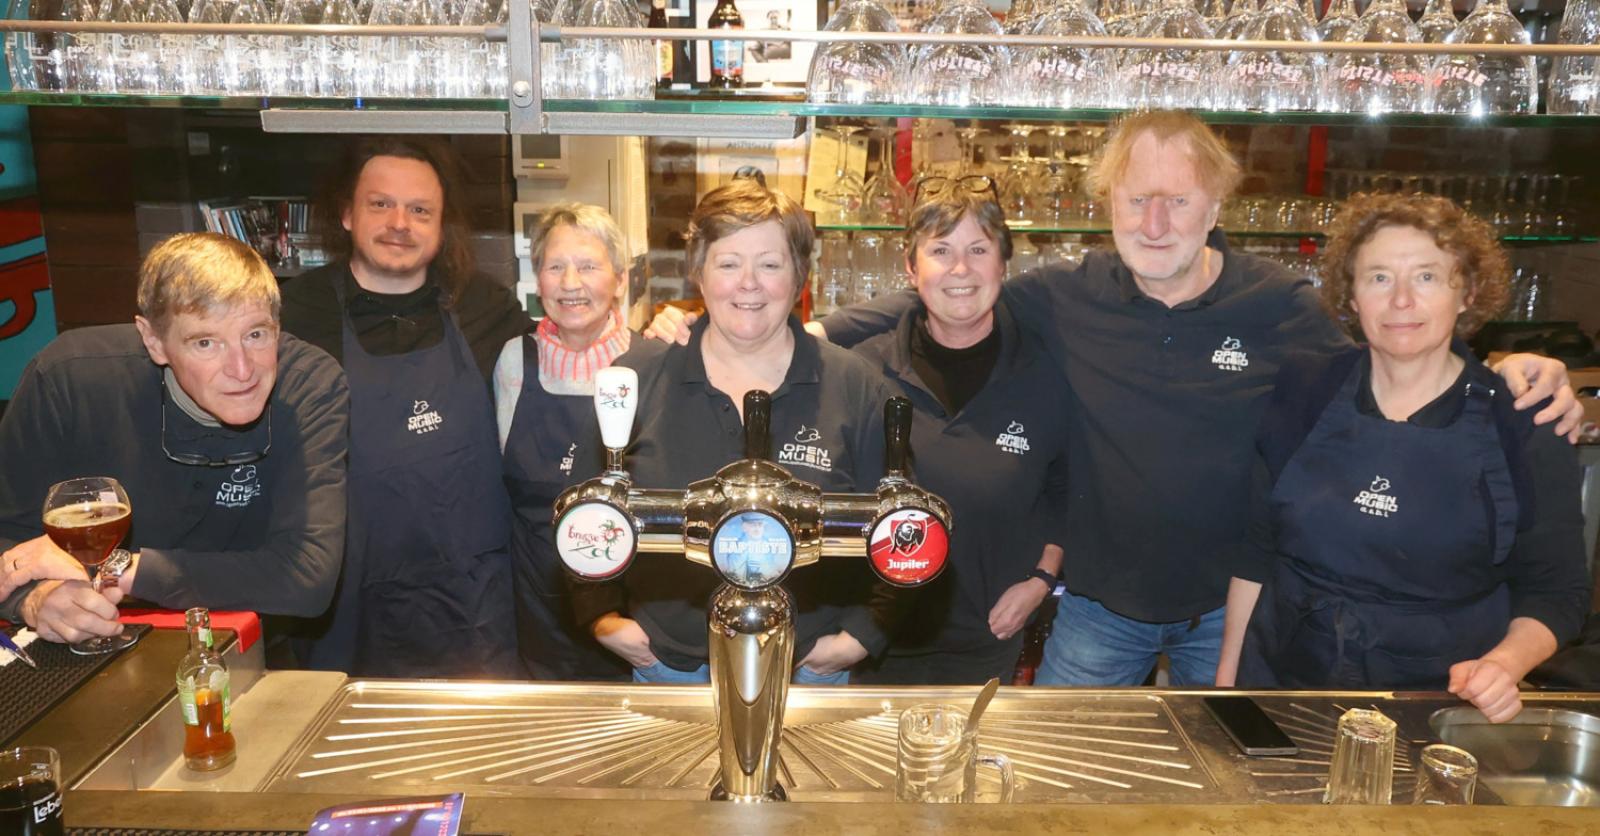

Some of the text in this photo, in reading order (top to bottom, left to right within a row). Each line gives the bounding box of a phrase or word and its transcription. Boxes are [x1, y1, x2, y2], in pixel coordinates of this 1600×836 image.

[1212, 356, 1248, 366] MUSIC
[1214, 350, 1247, 360] OPEN
[408, 411, 439, 423] OPEN
[408, 416, 443, 431] MUSIC
[783, 443, 828, 458] OPEN
[779, 450, 832, 467] MUSIC
[1353, 496, 1398, 513] MUSIC
[1359, 490, 1397, 505] OPEN
[718, 541, 787, 554] BAPTISTE
[887, 558, 930, 571] Jupiler
